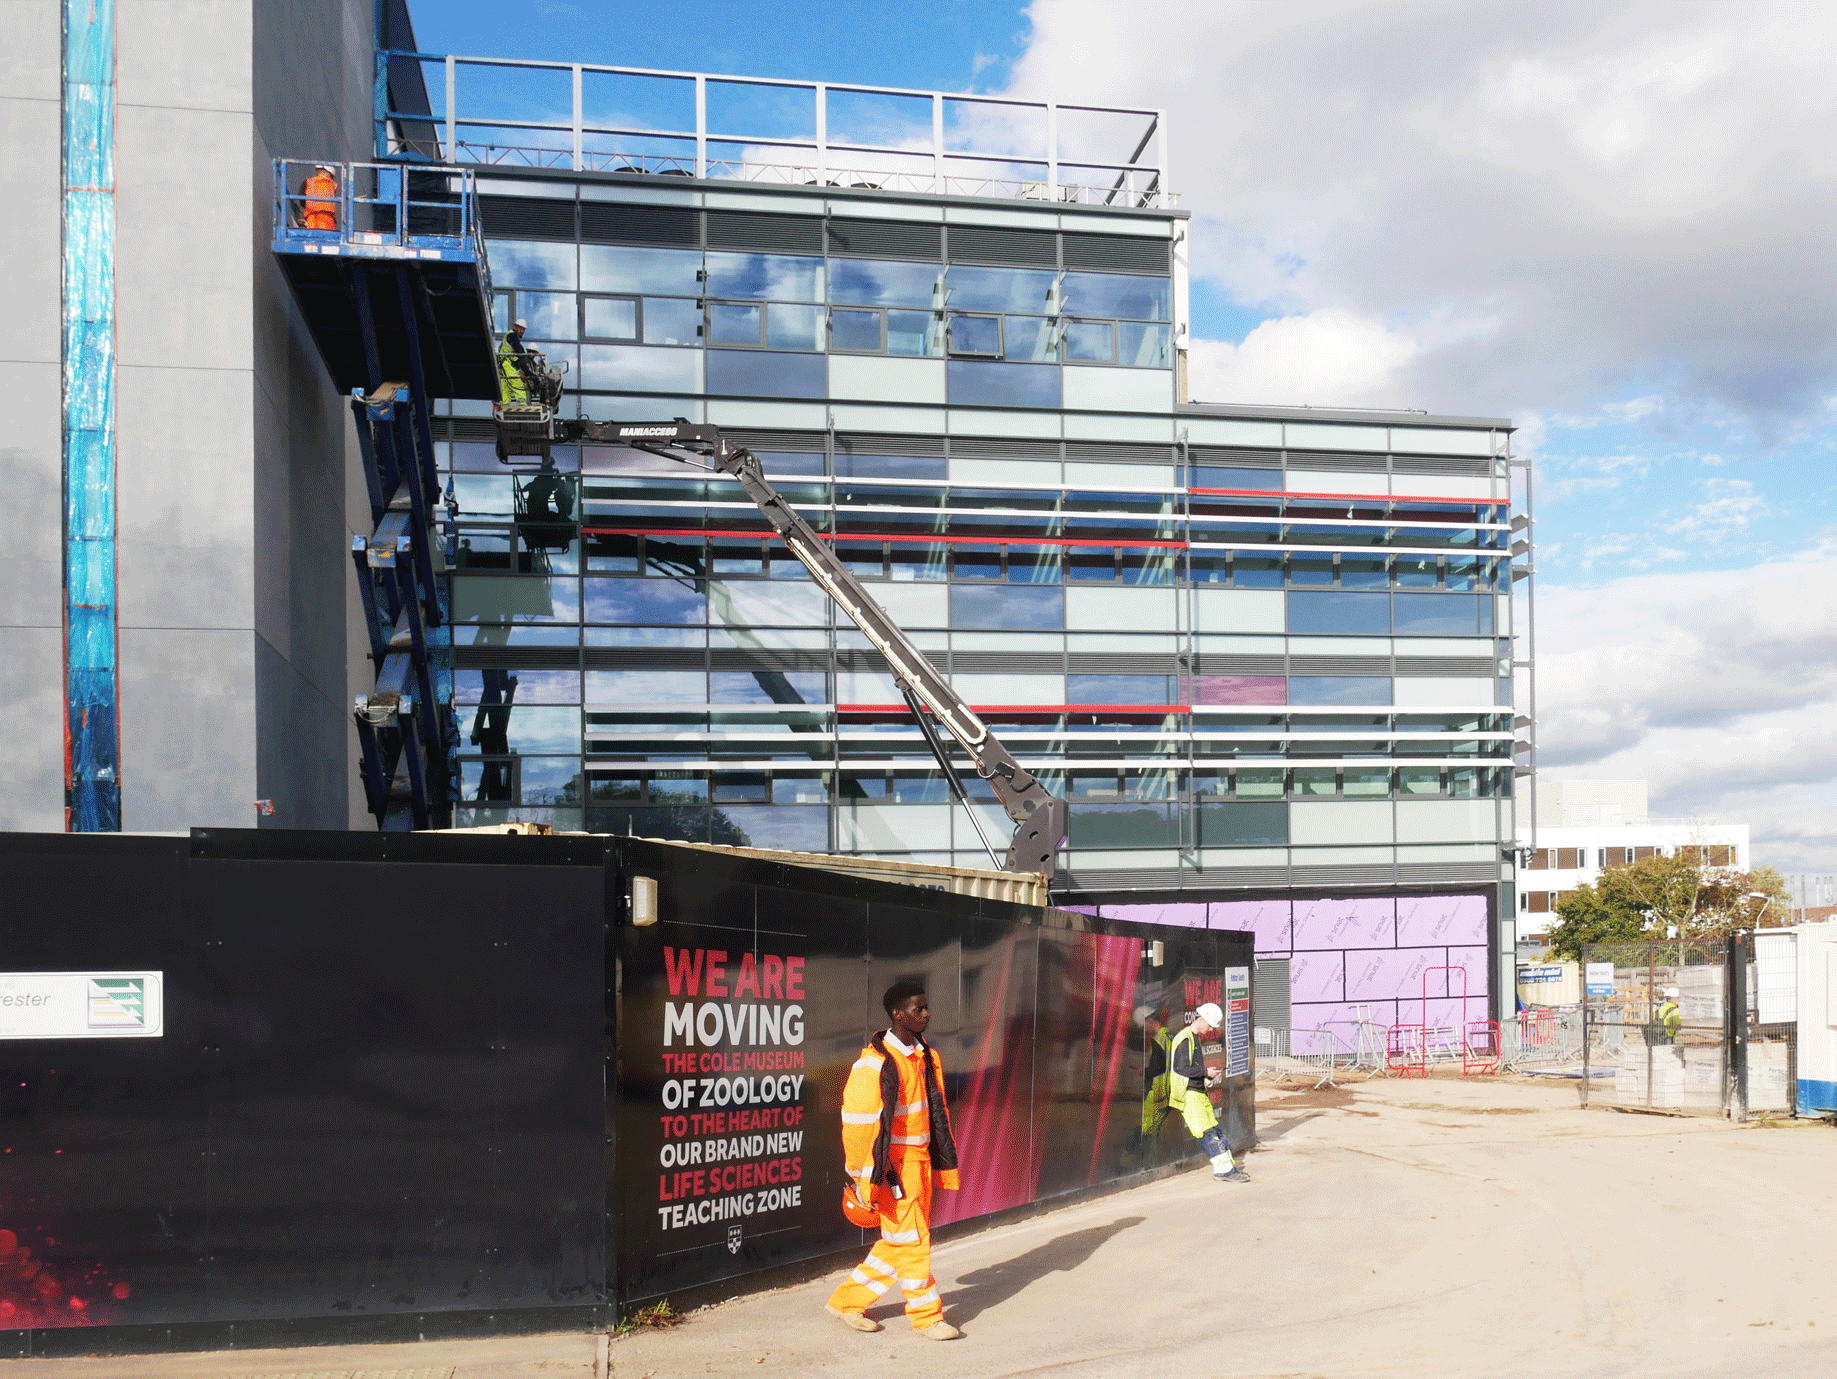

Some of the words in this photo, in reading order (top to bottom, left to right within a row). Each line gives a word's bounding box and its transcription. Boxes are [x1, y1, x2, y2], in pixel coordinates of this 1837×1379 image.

[619, 427, 678, 436] MANIACCESS
[664, 946, 728, 997] WE
[735, 953, 806, 1000] ARE
[0, 993, 51, 1007] ester
[1184, 980, 1202, 1006] WE
[1204, 980, 1222, 1005] ARE
[664, 1002, 805, 1046] MOVING
[662, 1053, 697, 1074] THE
[700, 1053, 741, 1073] COLE
[744, 1051, 805, 1071] MUSEUM
[662, 1079, 697, 1109] OF
[700, 1074, 805, 1107] ZOOLOGY
[660, 1115, 688, 1138] TO
[690, 1112, 726, 1136] THE
[728, 1108, 781, 1132] HEART
[783, 1106, 804, 1127] OF
[660, 1142, 702, 1168] OUR
[705, 1135, 764, 1163] BRAND
[767, 1131, 804, 1154] NEW
[659, 1171, 706, 1201] LIFE
[709, 1157, 802, 1194] SCIENCES
[658, 1196, 754, 1230] TEACHING
[757, 1185, 802, 1213] ZONE
